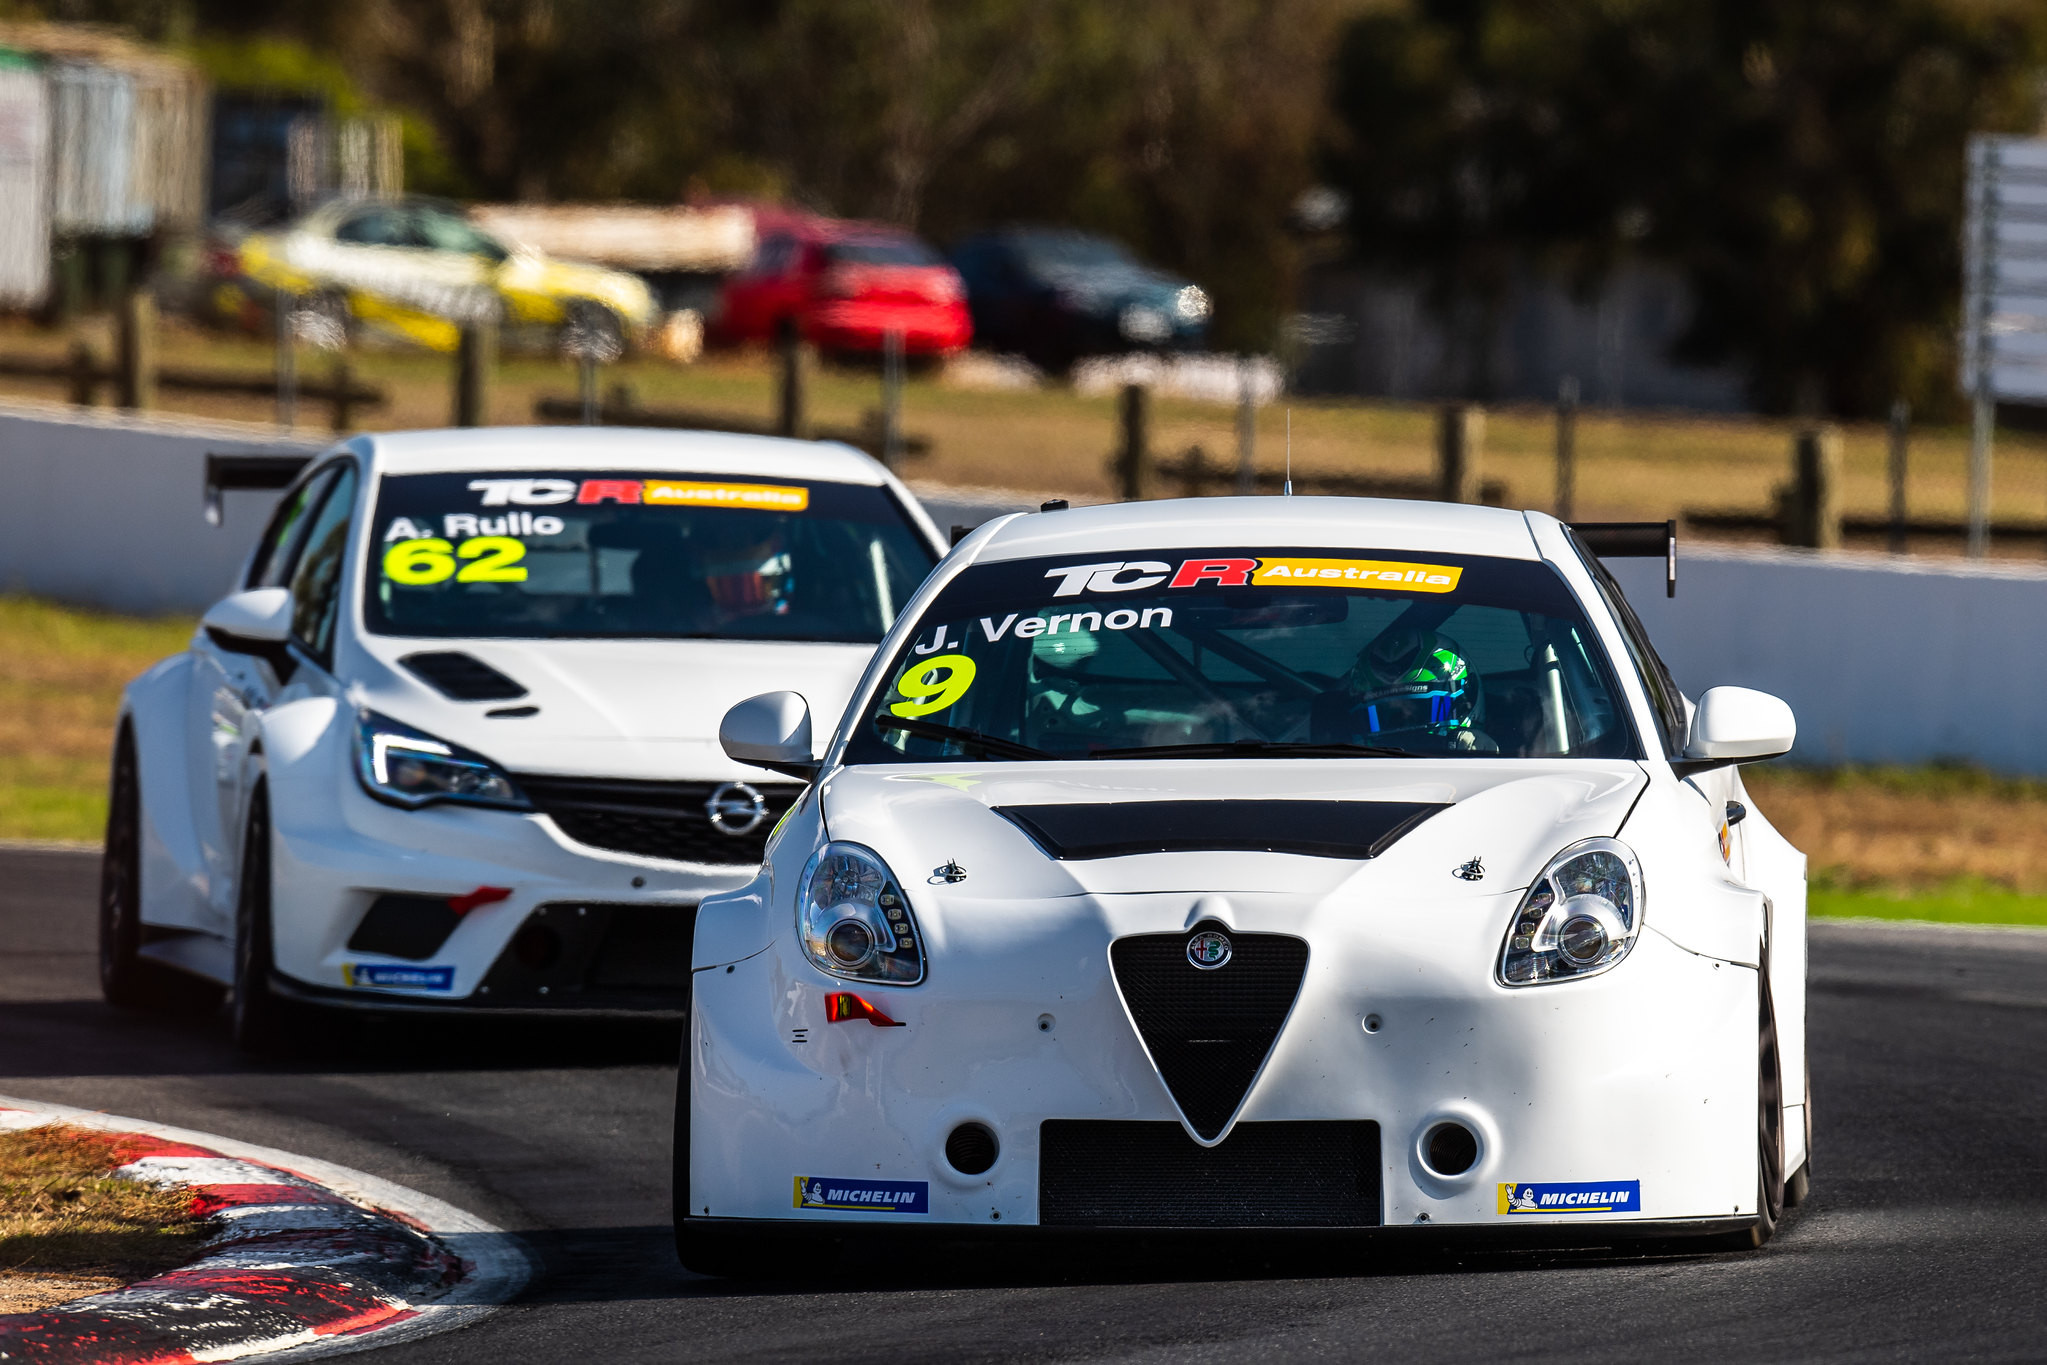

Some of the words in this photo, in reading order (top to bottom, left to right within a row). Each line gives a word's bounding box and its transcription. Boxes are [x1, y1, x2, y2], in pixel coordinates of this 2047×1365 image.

[467, 478, 643, 506] TCR
[652, 486, 802, 506] Australia
[384, 516, 434, 542] A.
[444, 512, 565, 538] Rullo
[383, 536, 528, 586] 62
[1044, 558, 1258, 597] TCR
[1262, 564, 1451, 586] Australia
[915, 625, 959, 655] J.
[980, 607, 1174, 643] Vernon
[890, 654, 977, 718] 9
[826, 1188, 916, 1204] MICHELIN
[1539, 1190, 1630, 1205] MICHELIN
